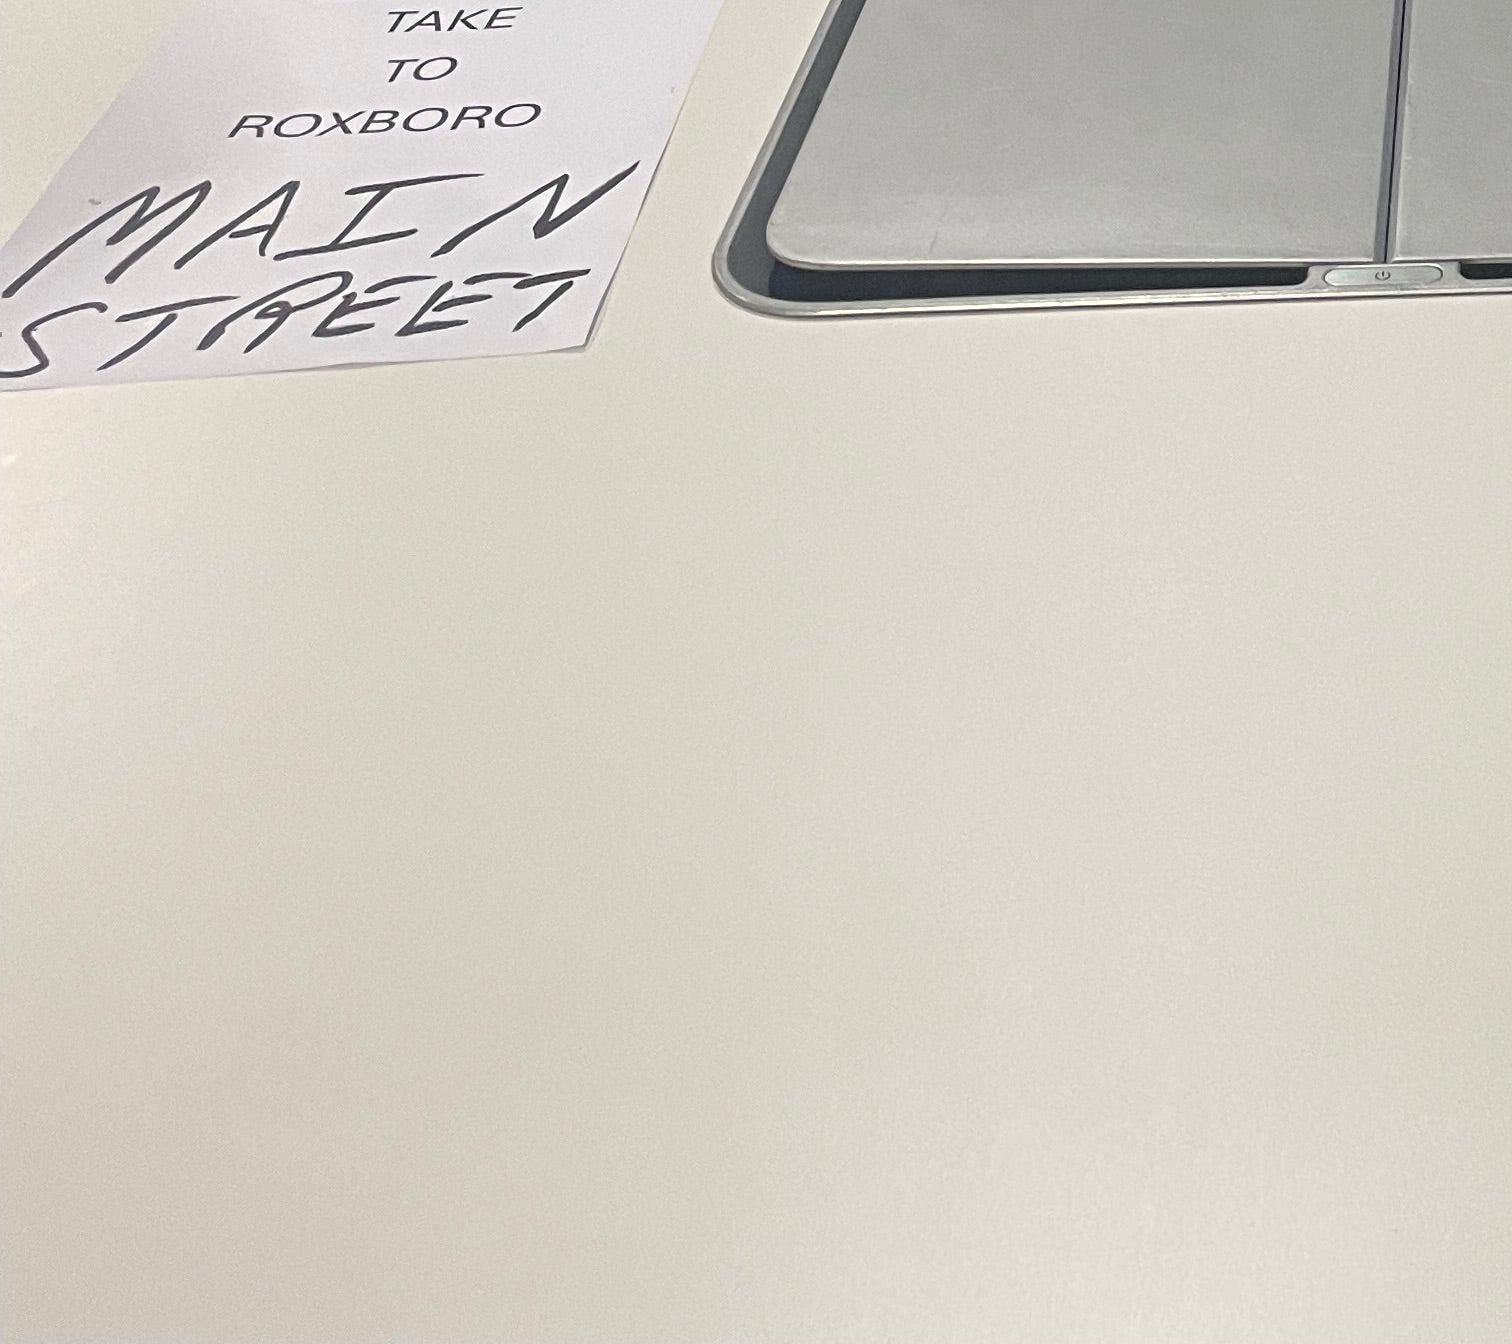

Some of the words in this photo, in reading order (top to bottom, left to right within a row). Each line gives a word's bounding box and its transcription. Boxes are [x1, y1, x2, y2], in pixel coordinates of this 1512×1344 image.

[386, 5, 523, 33] TAKE
[387, 56, 459, 83] TO
[226, 102, 542, 139] ROXBORO
[1, 159, 641, 299] MAIN
[0, 269, 592, 379] STREET
